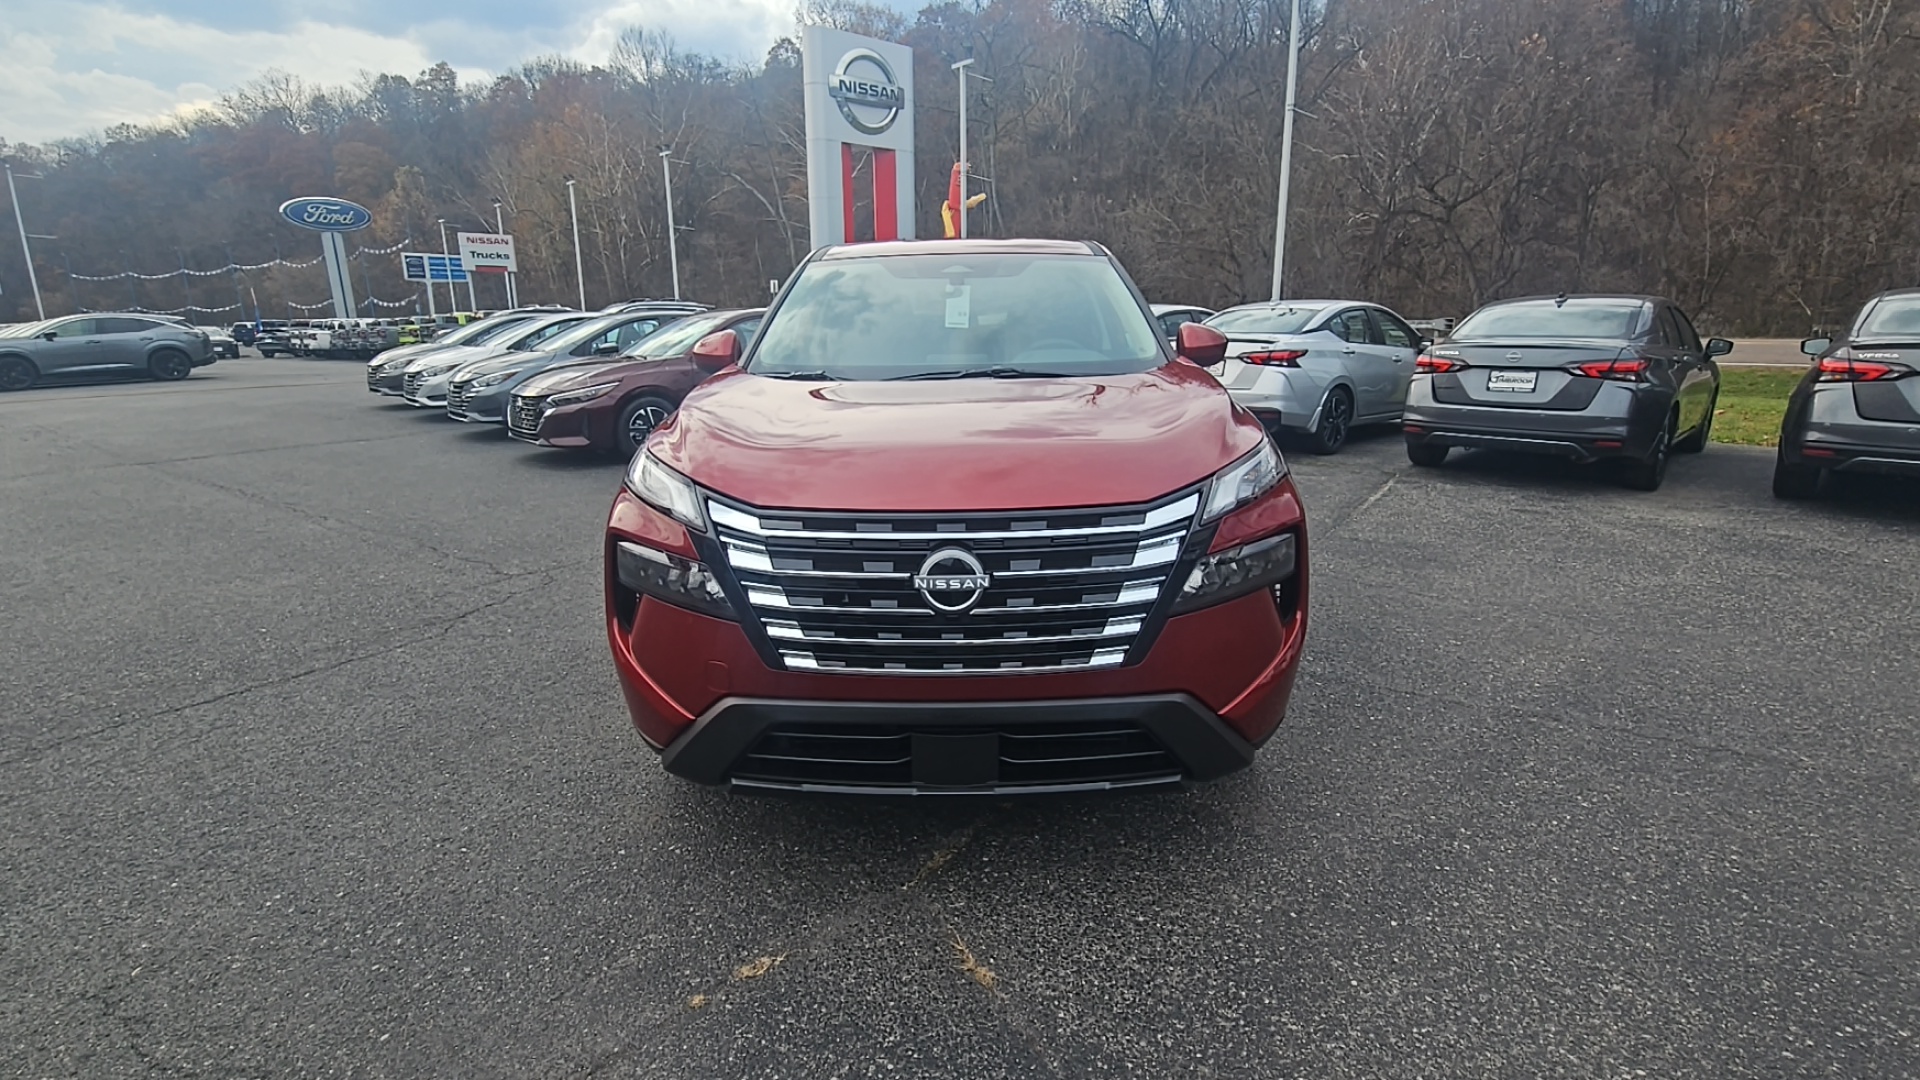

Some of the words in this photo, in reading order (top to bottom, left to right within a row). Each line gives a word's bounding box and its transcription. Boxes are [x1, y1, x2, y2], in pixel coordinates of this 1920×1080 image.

[839, 79, 899, 101] NISSAN
[303, 203, 354, 224] Ford
[466, 236, 509, 245] NISSAN
[469, 250, 510, 260] Trucks
[915, 578, 989, 589] NISSAN
